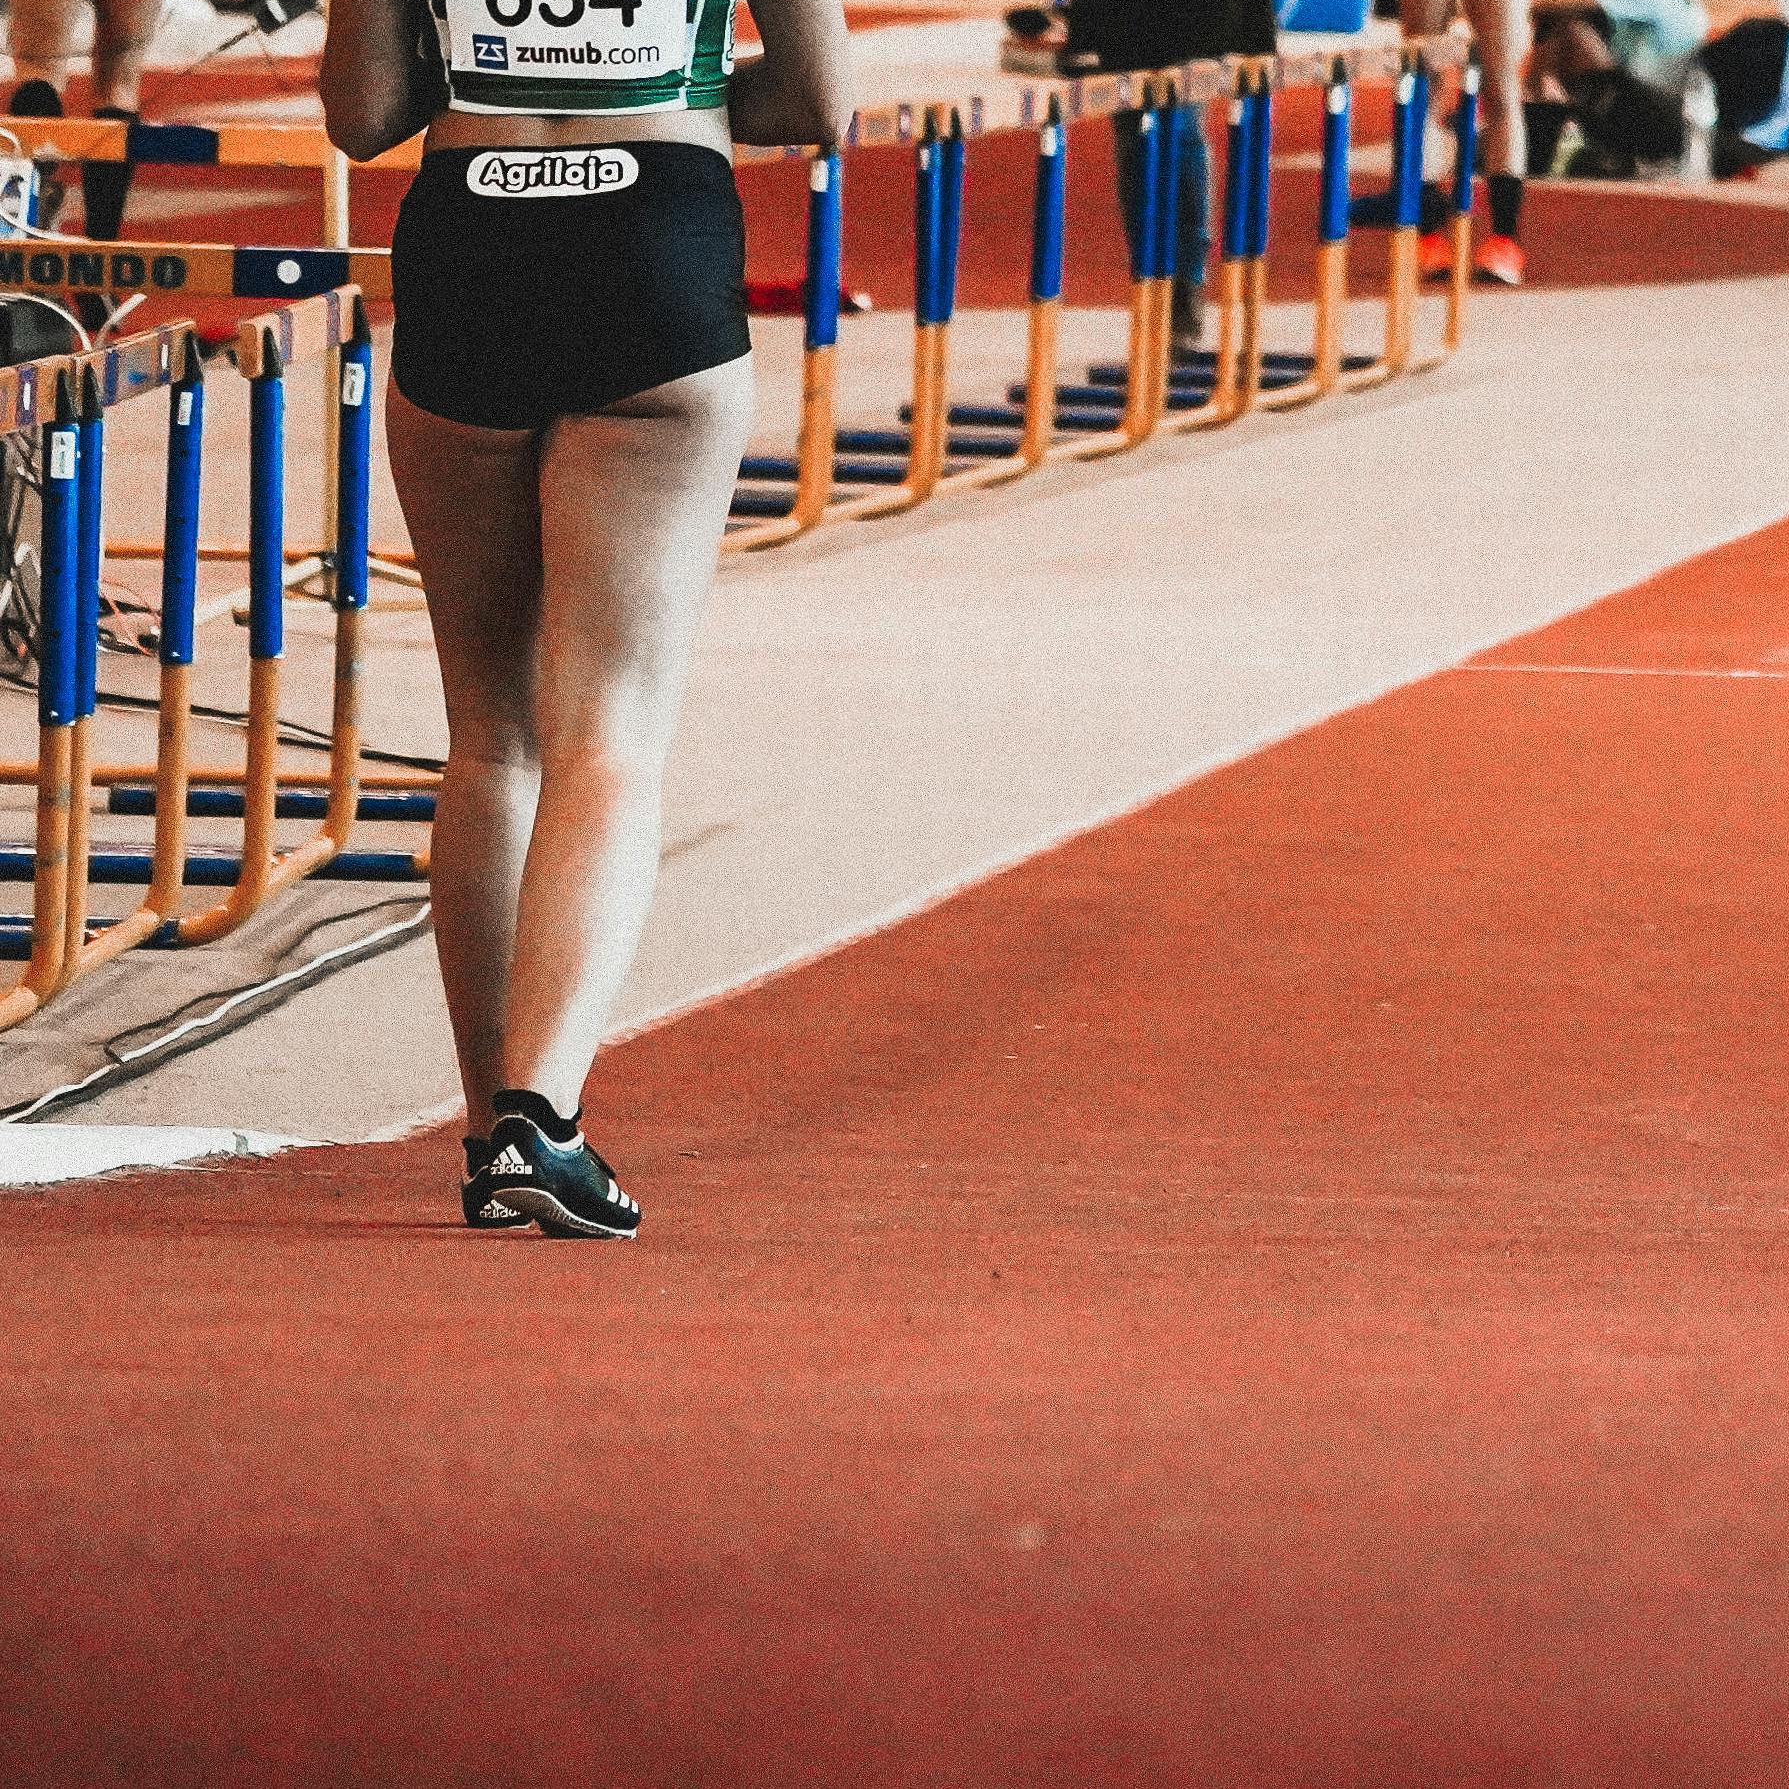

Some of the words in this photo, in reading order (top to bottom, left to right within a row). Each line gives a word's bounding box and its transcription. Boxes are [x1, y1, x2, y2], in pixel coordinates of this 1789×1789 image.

[516, 41, 660, 65] zumub.com
[479, 156, 624, 193] Agriloja
[479, 1206, 521, 1219] adida
